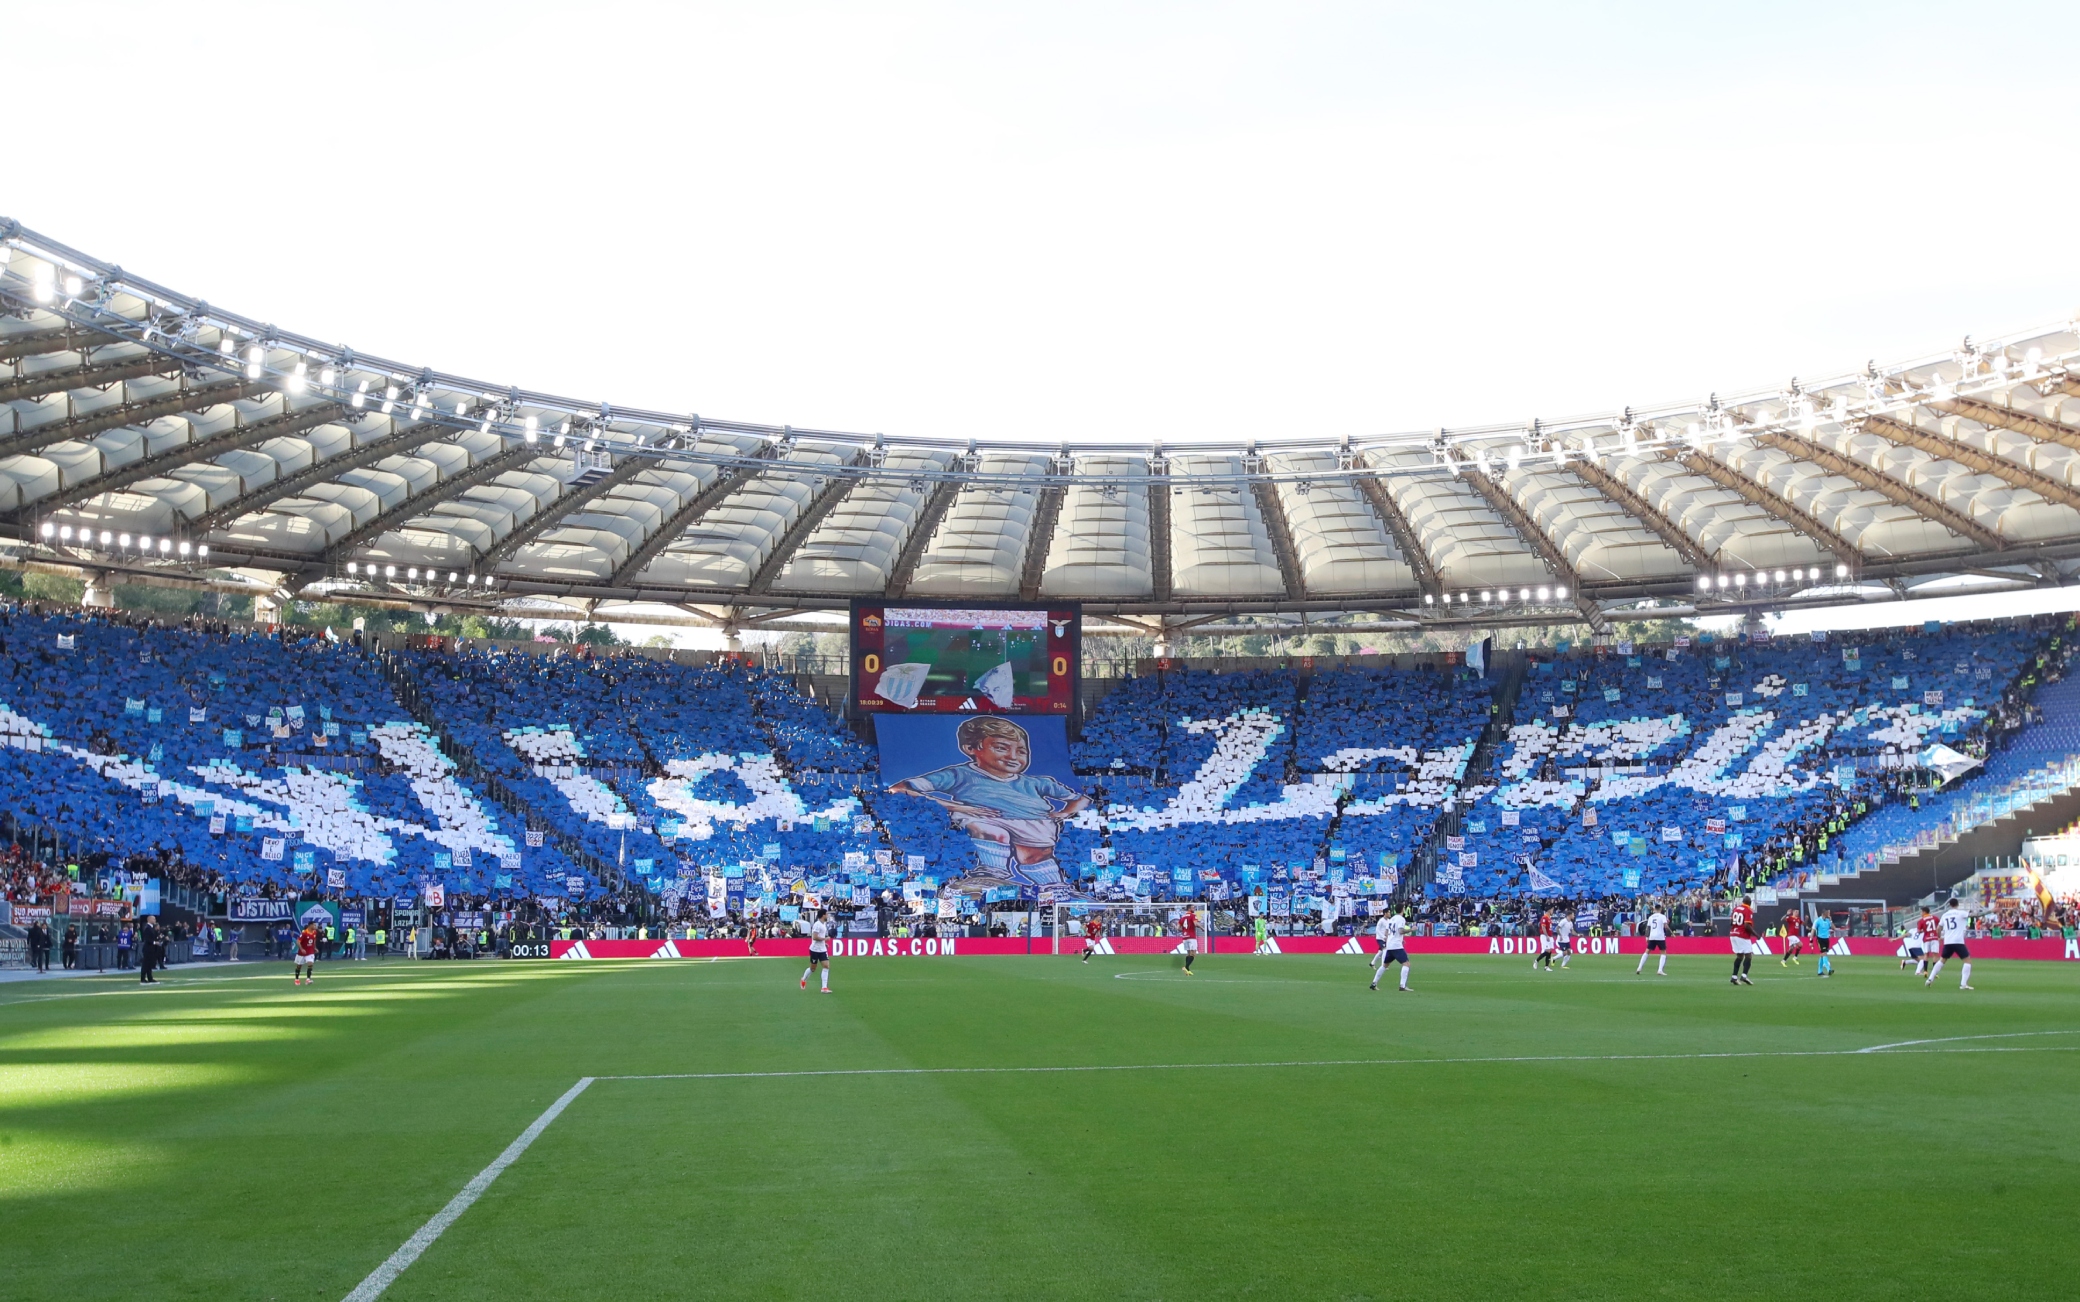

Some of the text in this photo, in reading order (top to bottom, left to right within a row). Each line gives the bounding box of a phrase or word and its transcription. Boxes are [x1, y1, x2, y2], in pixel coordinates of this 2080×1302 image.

[864, 653, 880, 674] 0
[1052, 656, 1068, 677] 0
[1792, 683, 1808, 697] SSL
[1381, 866, 1396, 875] NO
[1098, 873, 1114, 881] LAZIO
[1447, 886, 1466, 894] LAZIO
[433, 891, 443, 905] B
[14, 908, 51, 917] SUD PONTINO
[1732, 911, 1744, 926] 90
[1182, 918, 1189, 930] 4
[1651, 919, 1658, 930] 5
[1925, 920, 1937, 932] 21
[1945, 918, 1958, 930] 13
[512, 944, 549, 957] 00:13
[831, 938, 956, 957] DIDAS.COM
